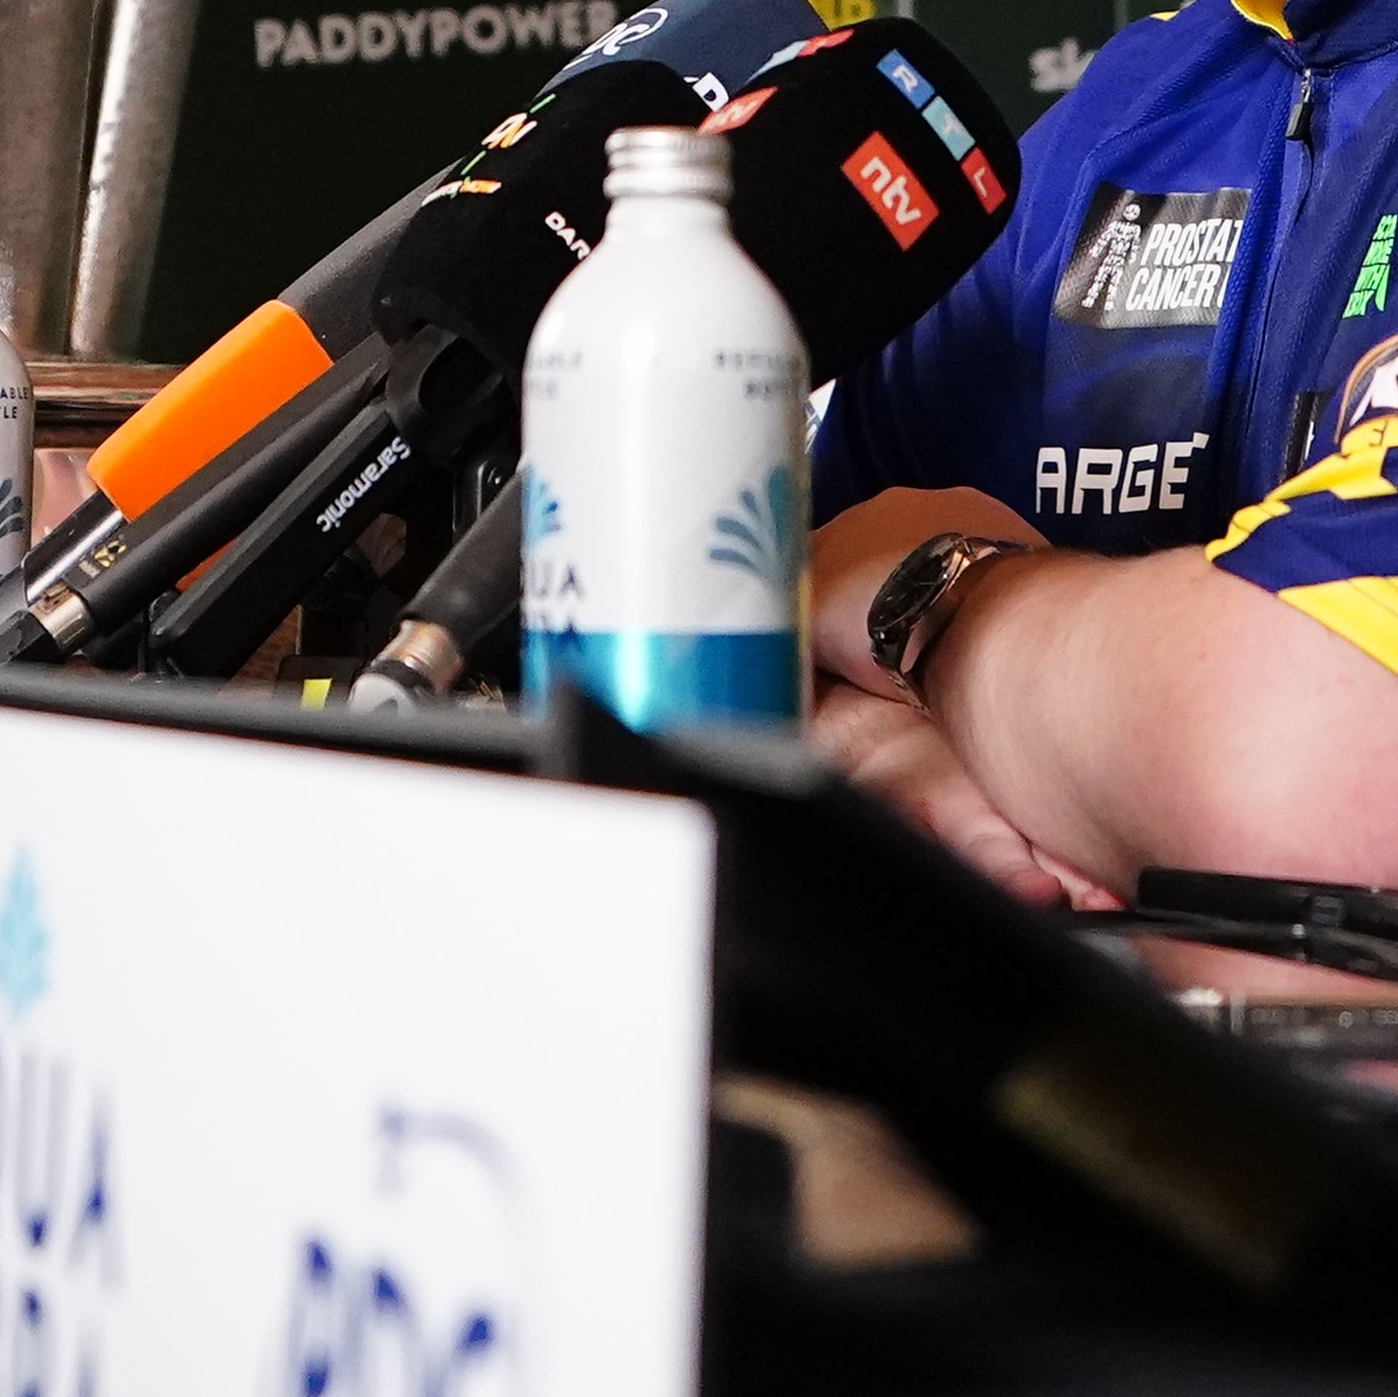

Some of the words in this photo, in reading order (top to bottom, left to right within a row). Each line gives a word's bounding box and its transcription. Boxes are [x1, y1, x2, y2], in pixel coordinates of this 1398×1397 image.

[860, 156, 922, 225] ntv
[545, 211, 590, 260] DAR
[1140, 218, 1244, 268] PROSTAT
[1125, 264, 1221, 311] CANCER
[315, 436, 411, 533] Saramonic
[1036, 432, 1211, 515] ARGE
